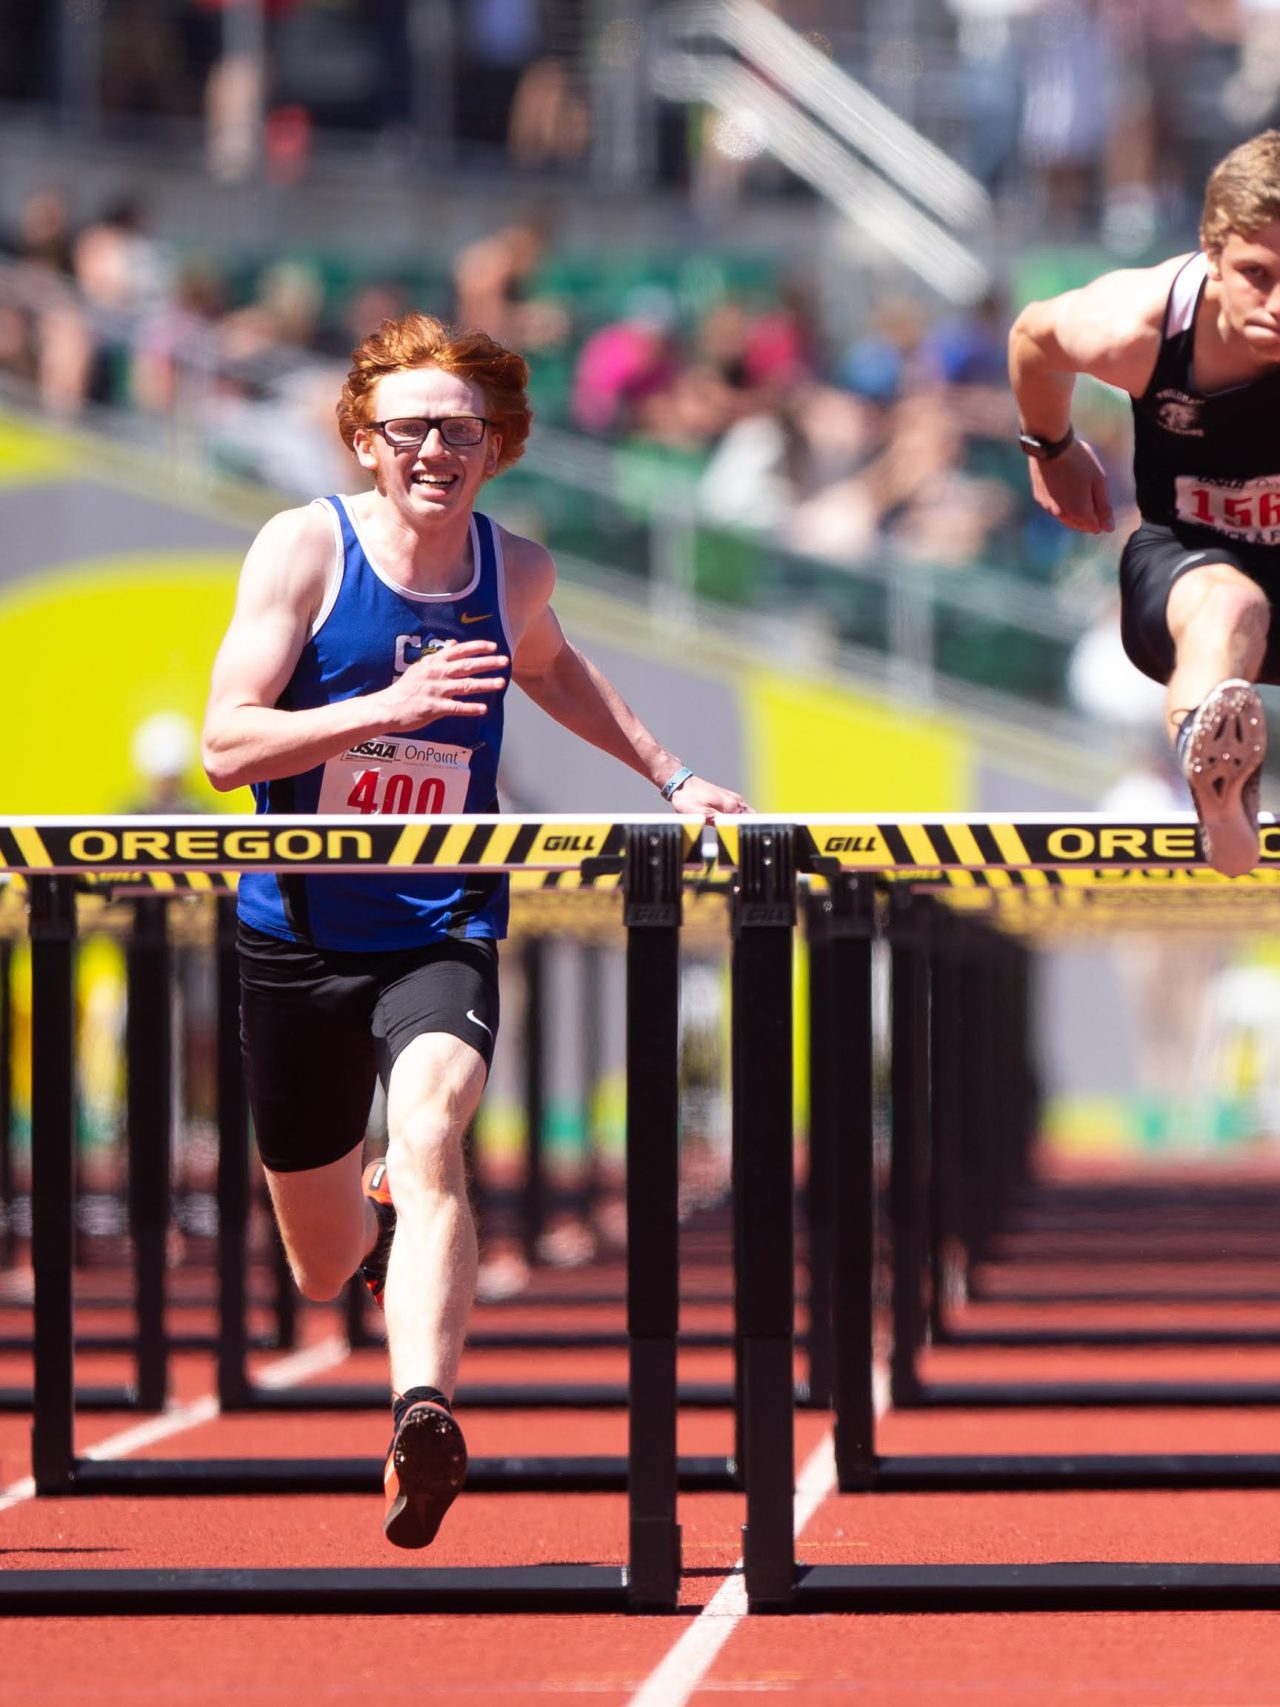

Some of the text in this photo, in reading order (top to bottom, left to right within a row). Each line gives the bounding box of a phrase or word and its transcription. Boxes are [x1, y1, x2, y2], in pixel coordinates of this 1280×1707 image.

[404, 744, 459, 765] OnPoint
[346, 769, 446, 814] 400
[69, 829, 372, 861] OREGON
[543, 836, 595, 851] GILL
[824, 836, 877, 852] GILL
